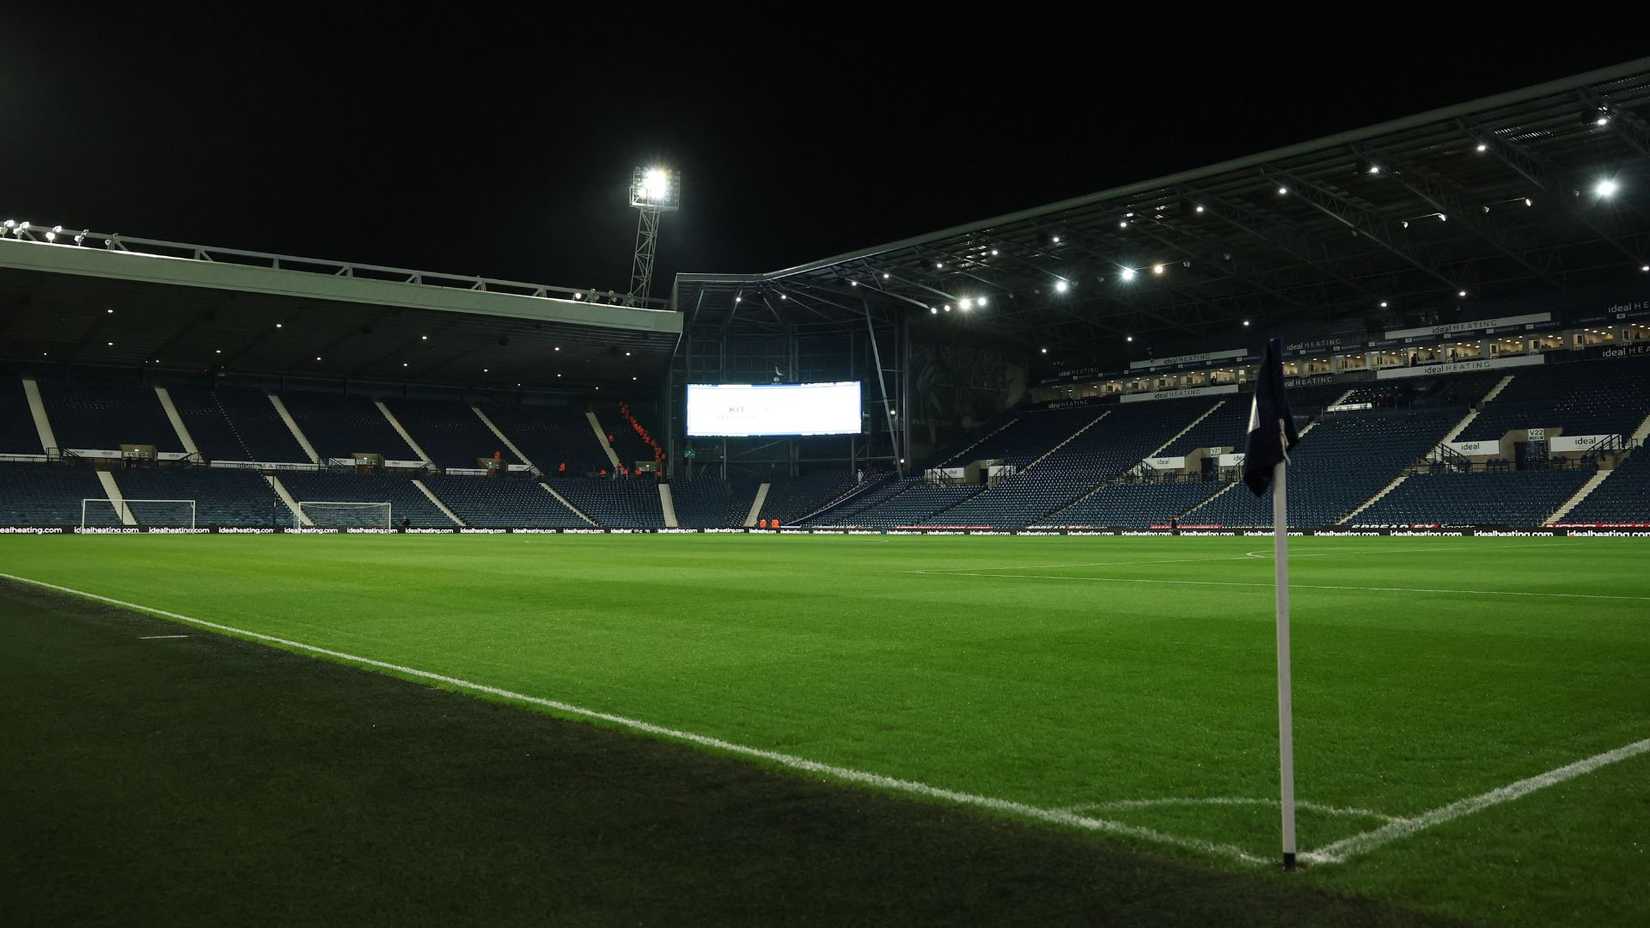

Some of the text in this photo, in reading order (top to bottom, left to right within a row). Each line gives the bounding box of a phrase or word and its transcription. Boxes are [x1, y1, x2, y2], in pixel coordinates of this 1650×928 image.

[1608, 303, 1632, 313] ideal
[1602, 347, 1626, 358] ideal
[1424, 361, 1489, 374] ideal HEATING
[1575, 436, 1597, 446] ideal
[1461, 443, 1480, 451] ideal
[0, 527, 62, 535] ealheating.com
